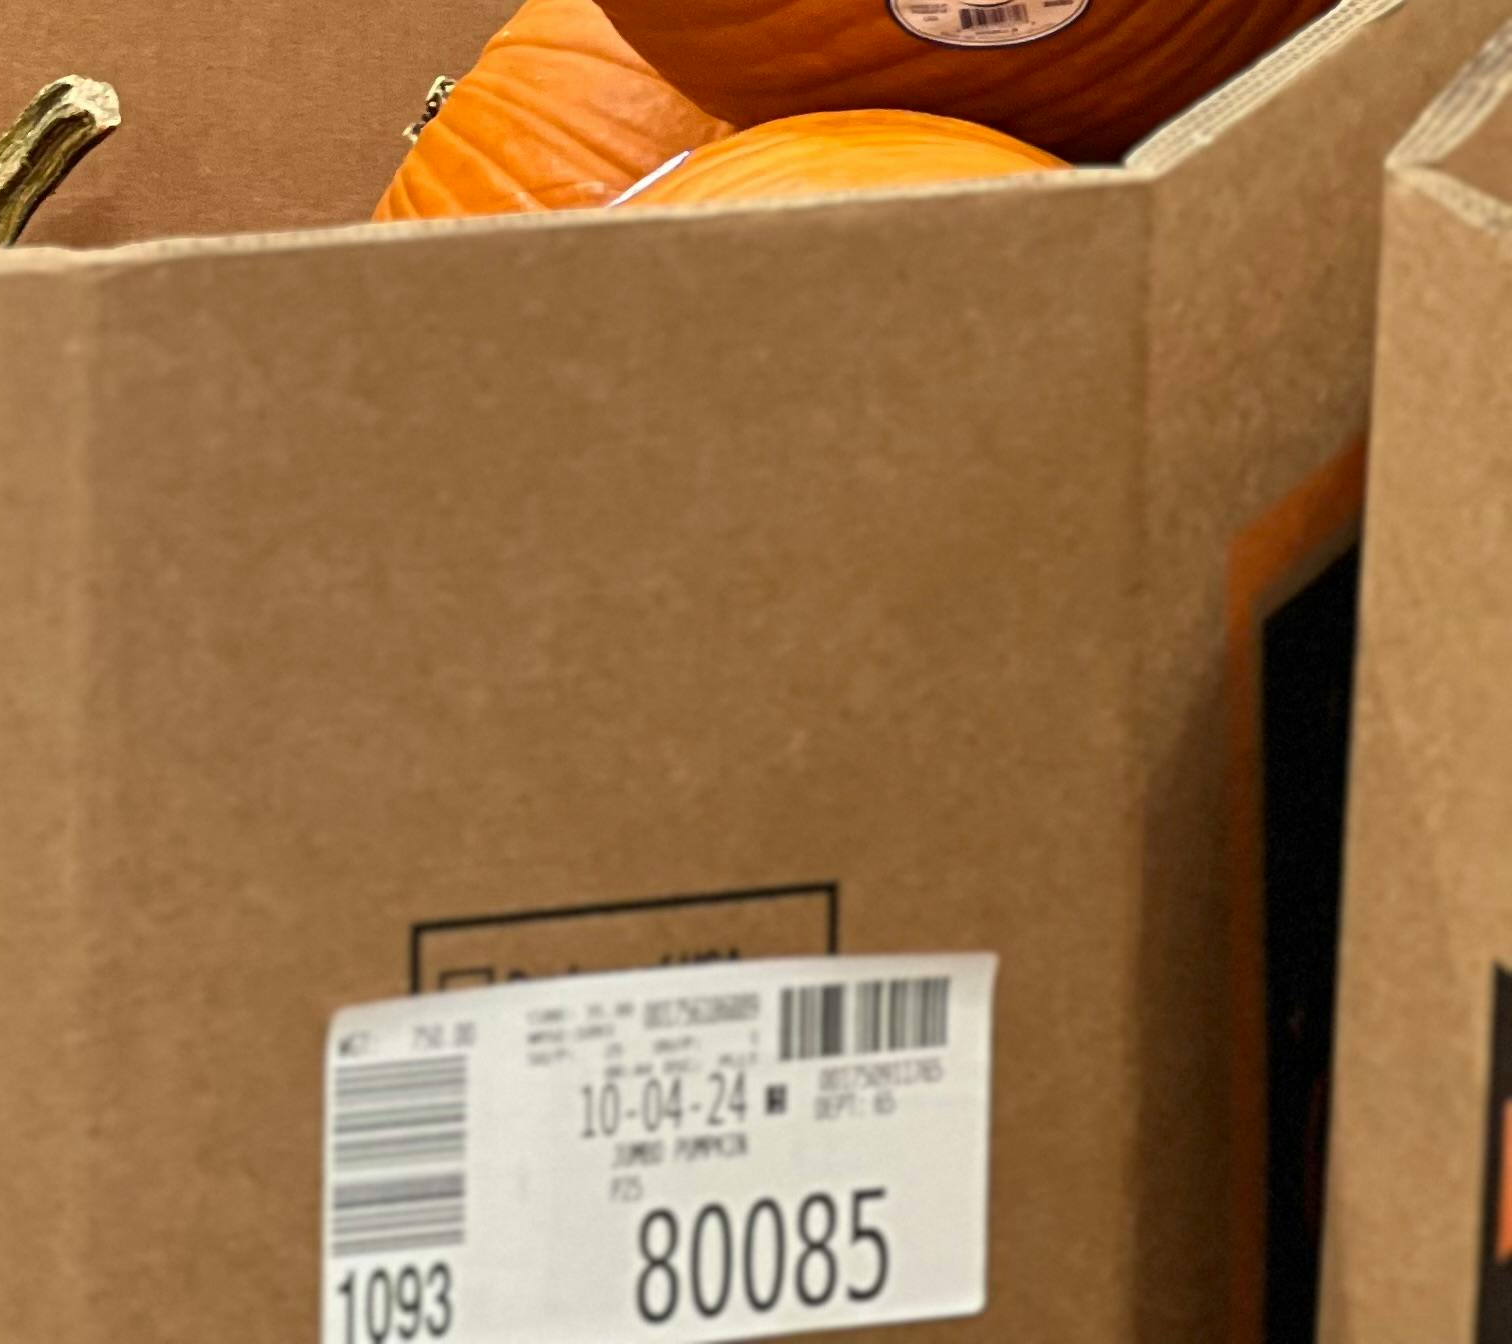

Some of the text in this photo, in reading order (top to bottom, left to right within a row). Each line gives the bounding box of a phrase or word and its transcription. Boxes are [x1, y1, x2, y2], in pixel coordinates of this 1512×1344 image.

[580, 1068, 748, 1140] 10-04-24
[636, 1186, 890, 1325] 80085
[338, 1259, 454, 1344] 1093
